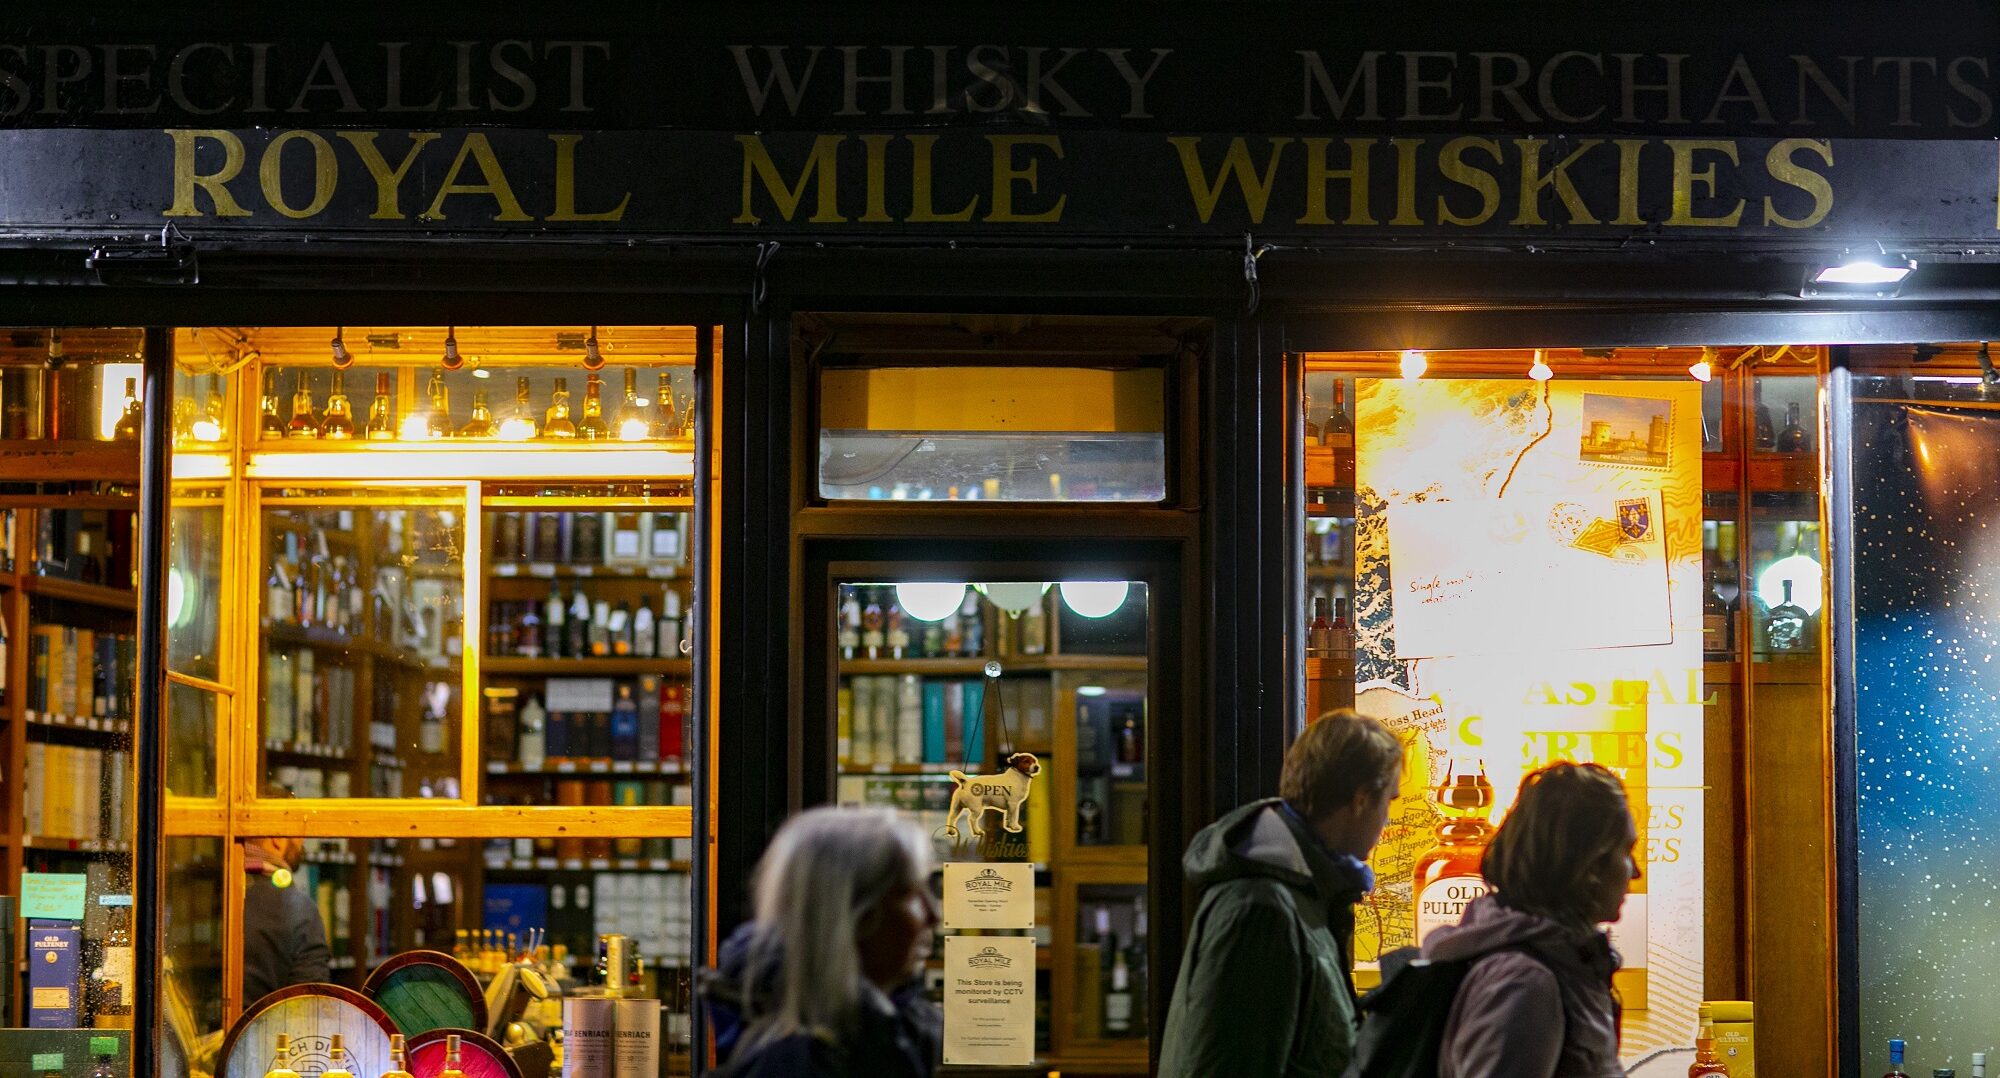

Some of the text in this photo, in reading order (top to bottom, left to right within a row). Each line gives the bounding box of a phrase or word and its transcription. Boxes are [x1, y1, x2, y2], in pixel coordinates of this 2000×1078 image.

[0, 40, 1995, 129] SPECIALIST WHISKY MERCHANTS
[163, 128, 1835, 230] ROYAL MILE WHISKIES
[1412, 703, 1444, 721] Head
[971, 783, 1012, 797] OPEN
[966, 881, 1012, 889] ROYAL MILE
[1447, 886, 1485, 900] OLD
[1423, 901, 1471, 915] PULT
[1002, 979, 1023, 988] being
[992, 988, 1002, 997] by
[574, 1030, 610, 1038] BENRIACH
